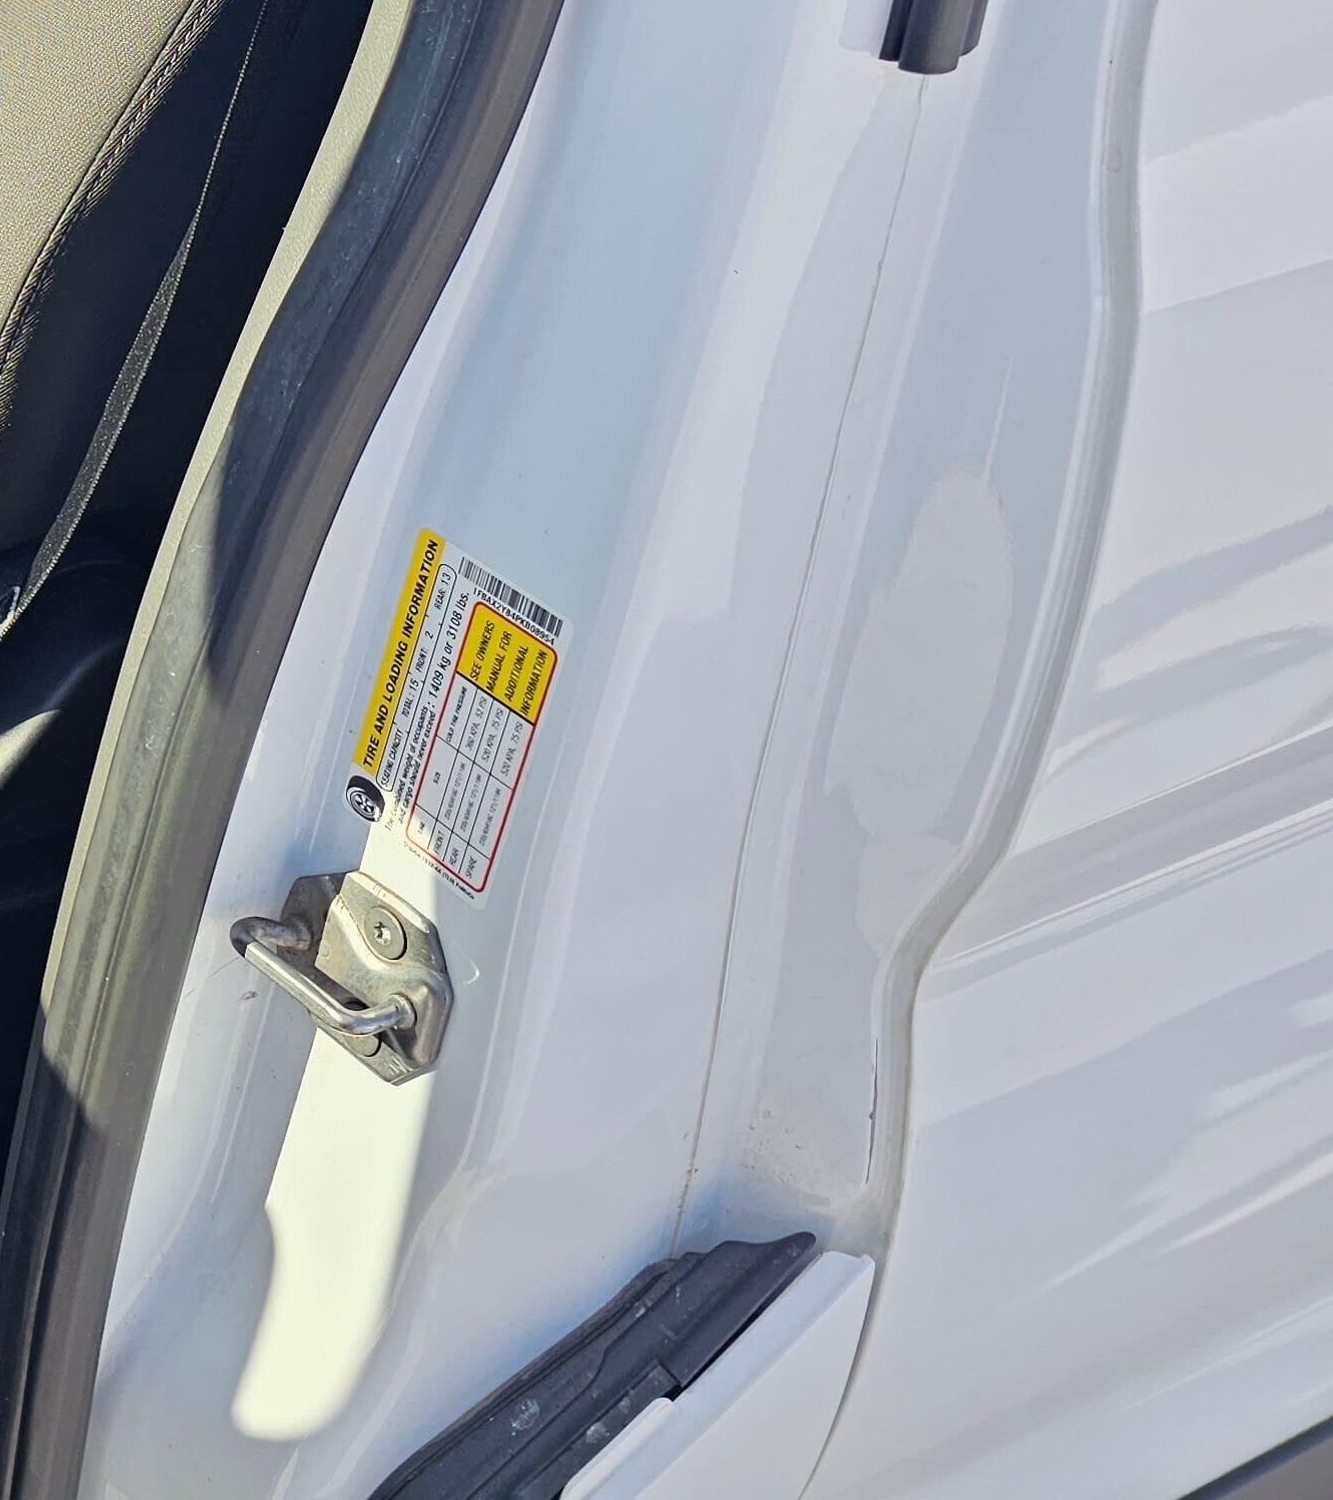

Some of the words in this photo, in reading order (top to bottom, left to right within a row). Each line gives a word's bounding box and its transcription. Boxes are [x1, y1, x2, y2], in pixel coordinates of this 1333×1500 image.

[454, 587, 469, 611] lbs.
[445, 609, 462, 640] 3108
[362, 734, 379, 769] TIRE
[372, 702, 389, 735] AND
[382, 639, 408, 703] LOADING
[401, 537, 438, 639] INFORMATION
[442, 640, 453, 655] or
[475, 618, 495, 662] OWNERS
[436, 652, 451, 672] kg
[469, 660, 482, 681] SEE
[485, 650, 505, 693] MANUAL
[498, 629, 512, 652] FOR
[502, 642, 528, 702] ADDITIONAL
[380, 758, 393, 787] SEATING
[388, 727, 404, 761] CAPACITY
[408, 677, 419, 692] 15
[424, 629, 433, 639] 2
[440, 571, 450, 585] 13
[427, 669, 444, 700] 1409
[518, 648, 547, 716] INFORMATION
[410, 704, 428, 745] occupants
[421, 709, 436, 739] exceed
[408, 742, 416, 754] of
[416, 738, 427, 761] never
[480, 746, 491, 762] 520
[490, 718, 500, 731] 75
[400, 752, 415, 780] weight
[407, 759, 421, 787] should
[401, 785, 414, 809] cargo
[463, 855, 477, 879] SPARE
[500, 760, 511, 777] 520
[510, 731, 520, 744] 75
[432, 829, 445, 855] FRONT
